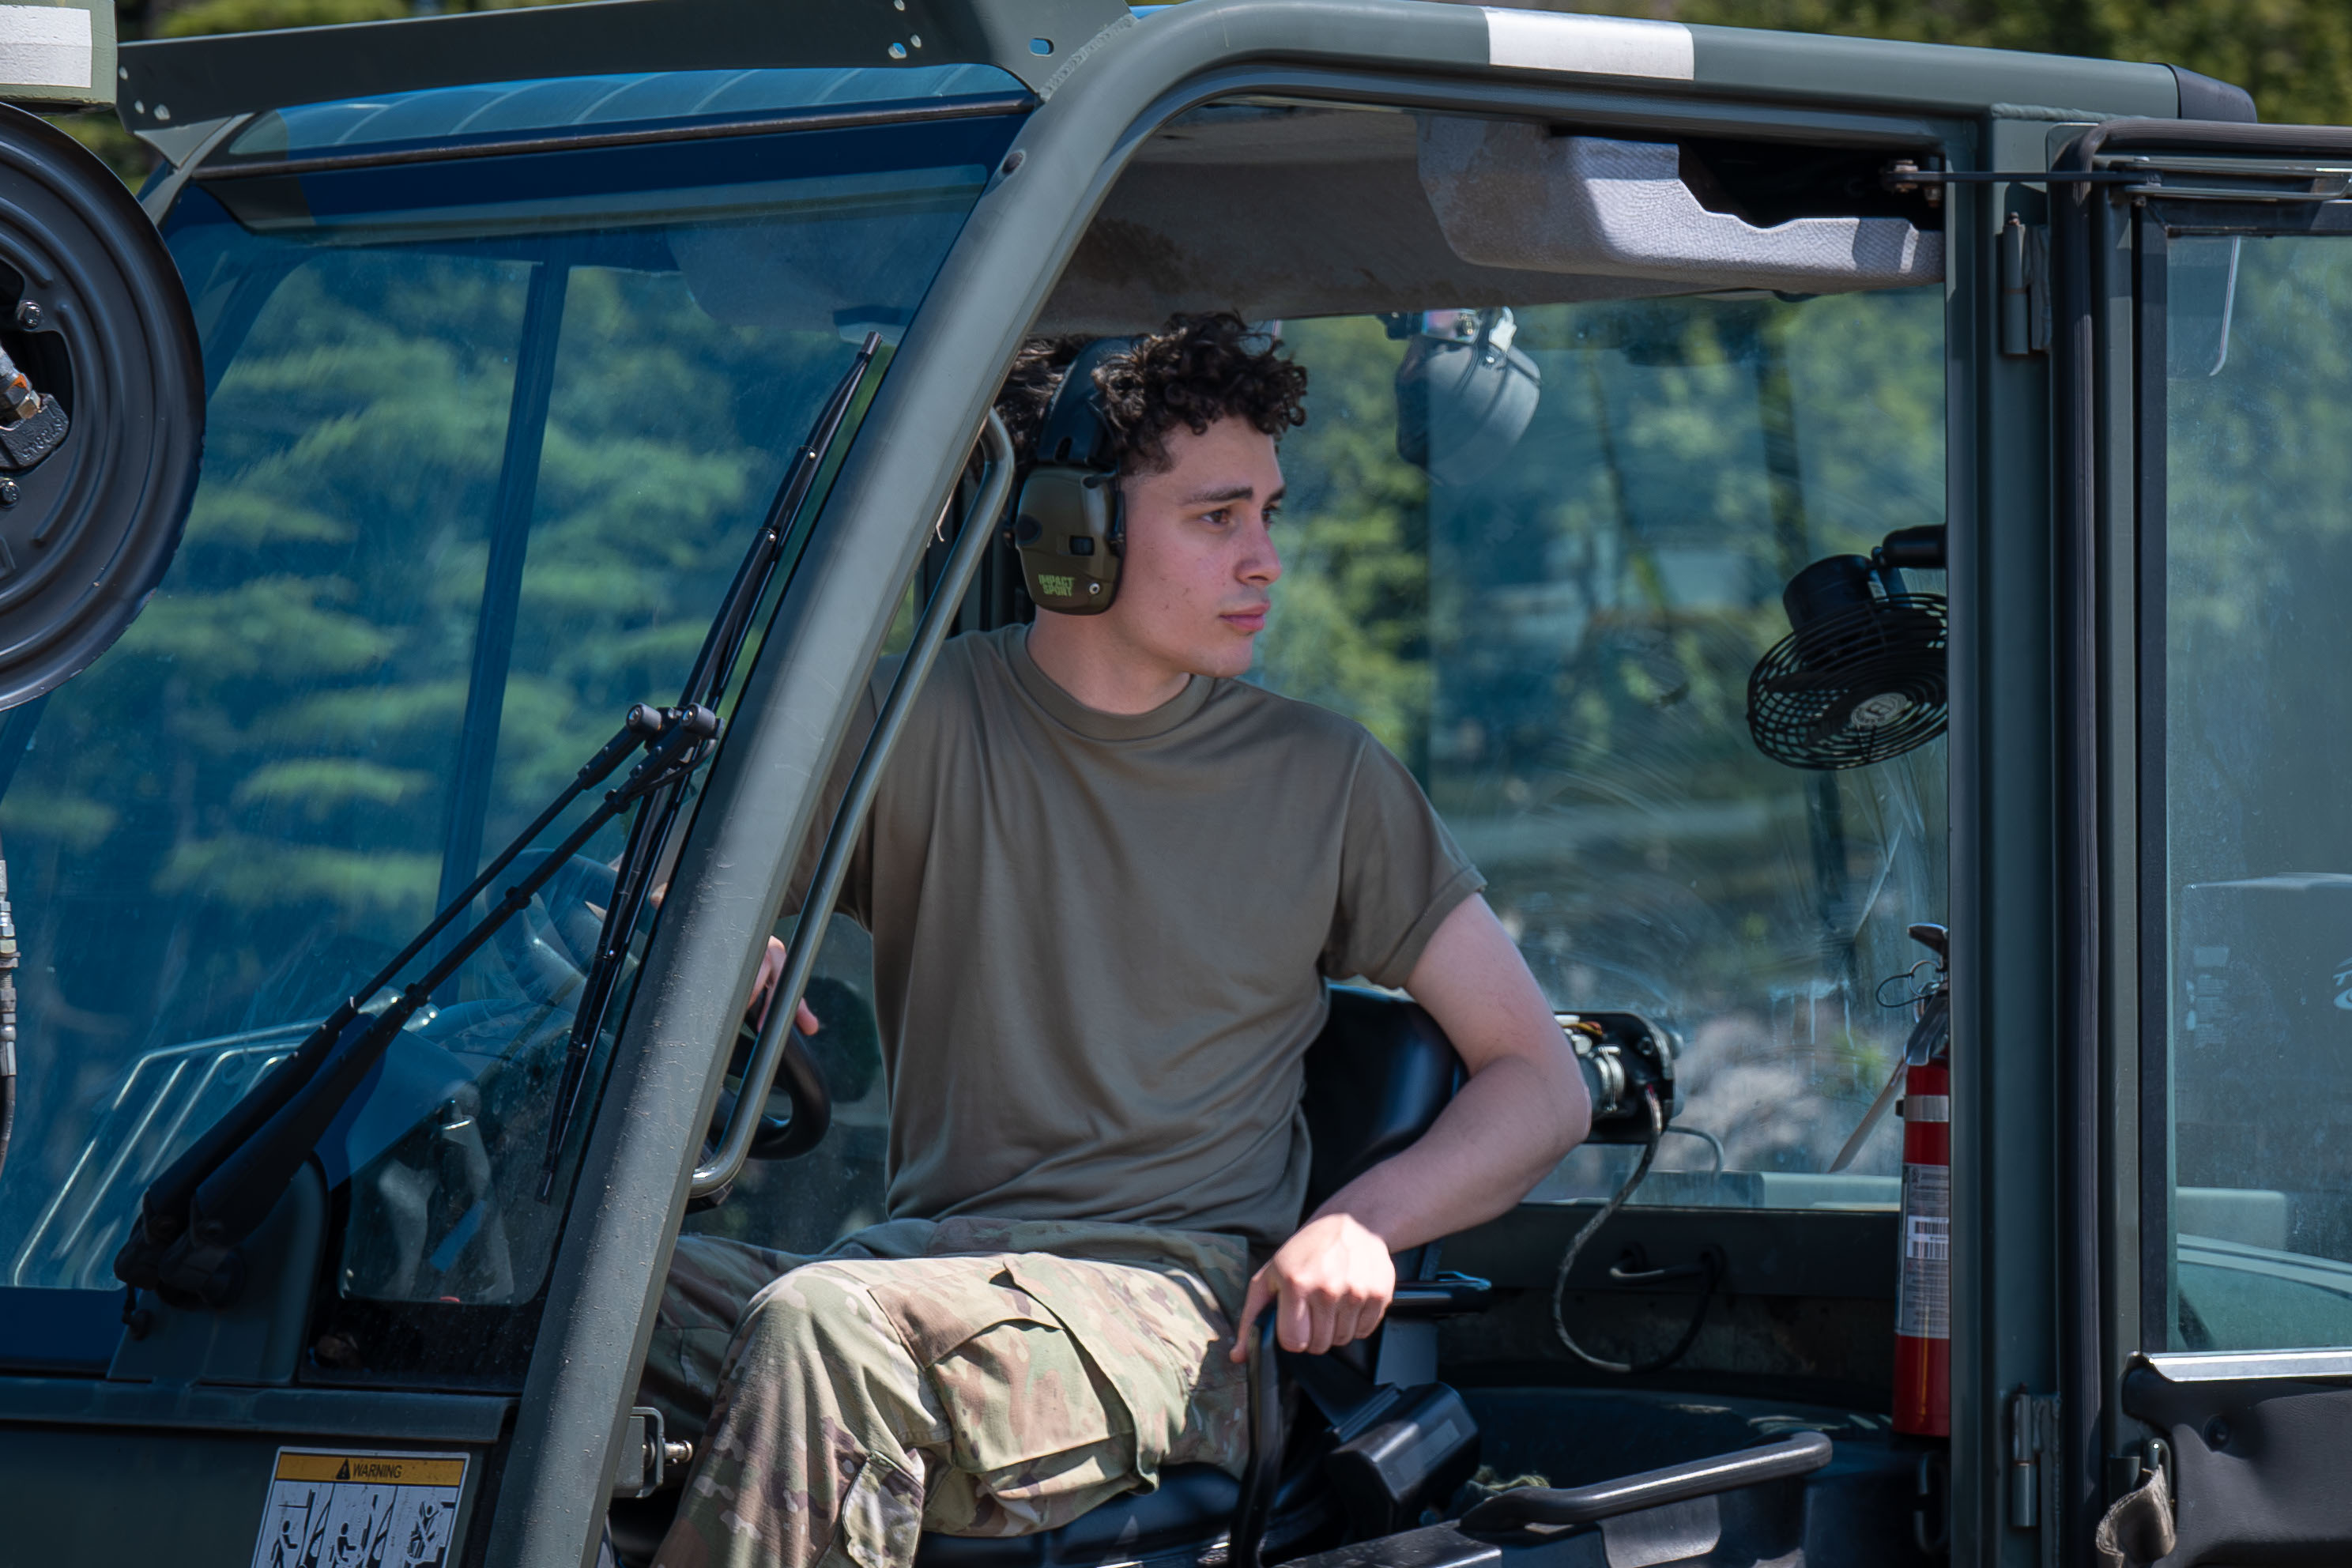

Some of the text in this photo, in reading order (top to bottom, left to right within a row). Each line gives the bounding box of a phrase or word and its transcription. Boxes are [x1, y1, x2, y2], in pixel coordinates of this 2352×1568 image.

[1038, 574, 1075, 587] IMPACT
[1043, 583, 1072, 597] SPORT
[352, 1462, 403, 1479] WARNING
